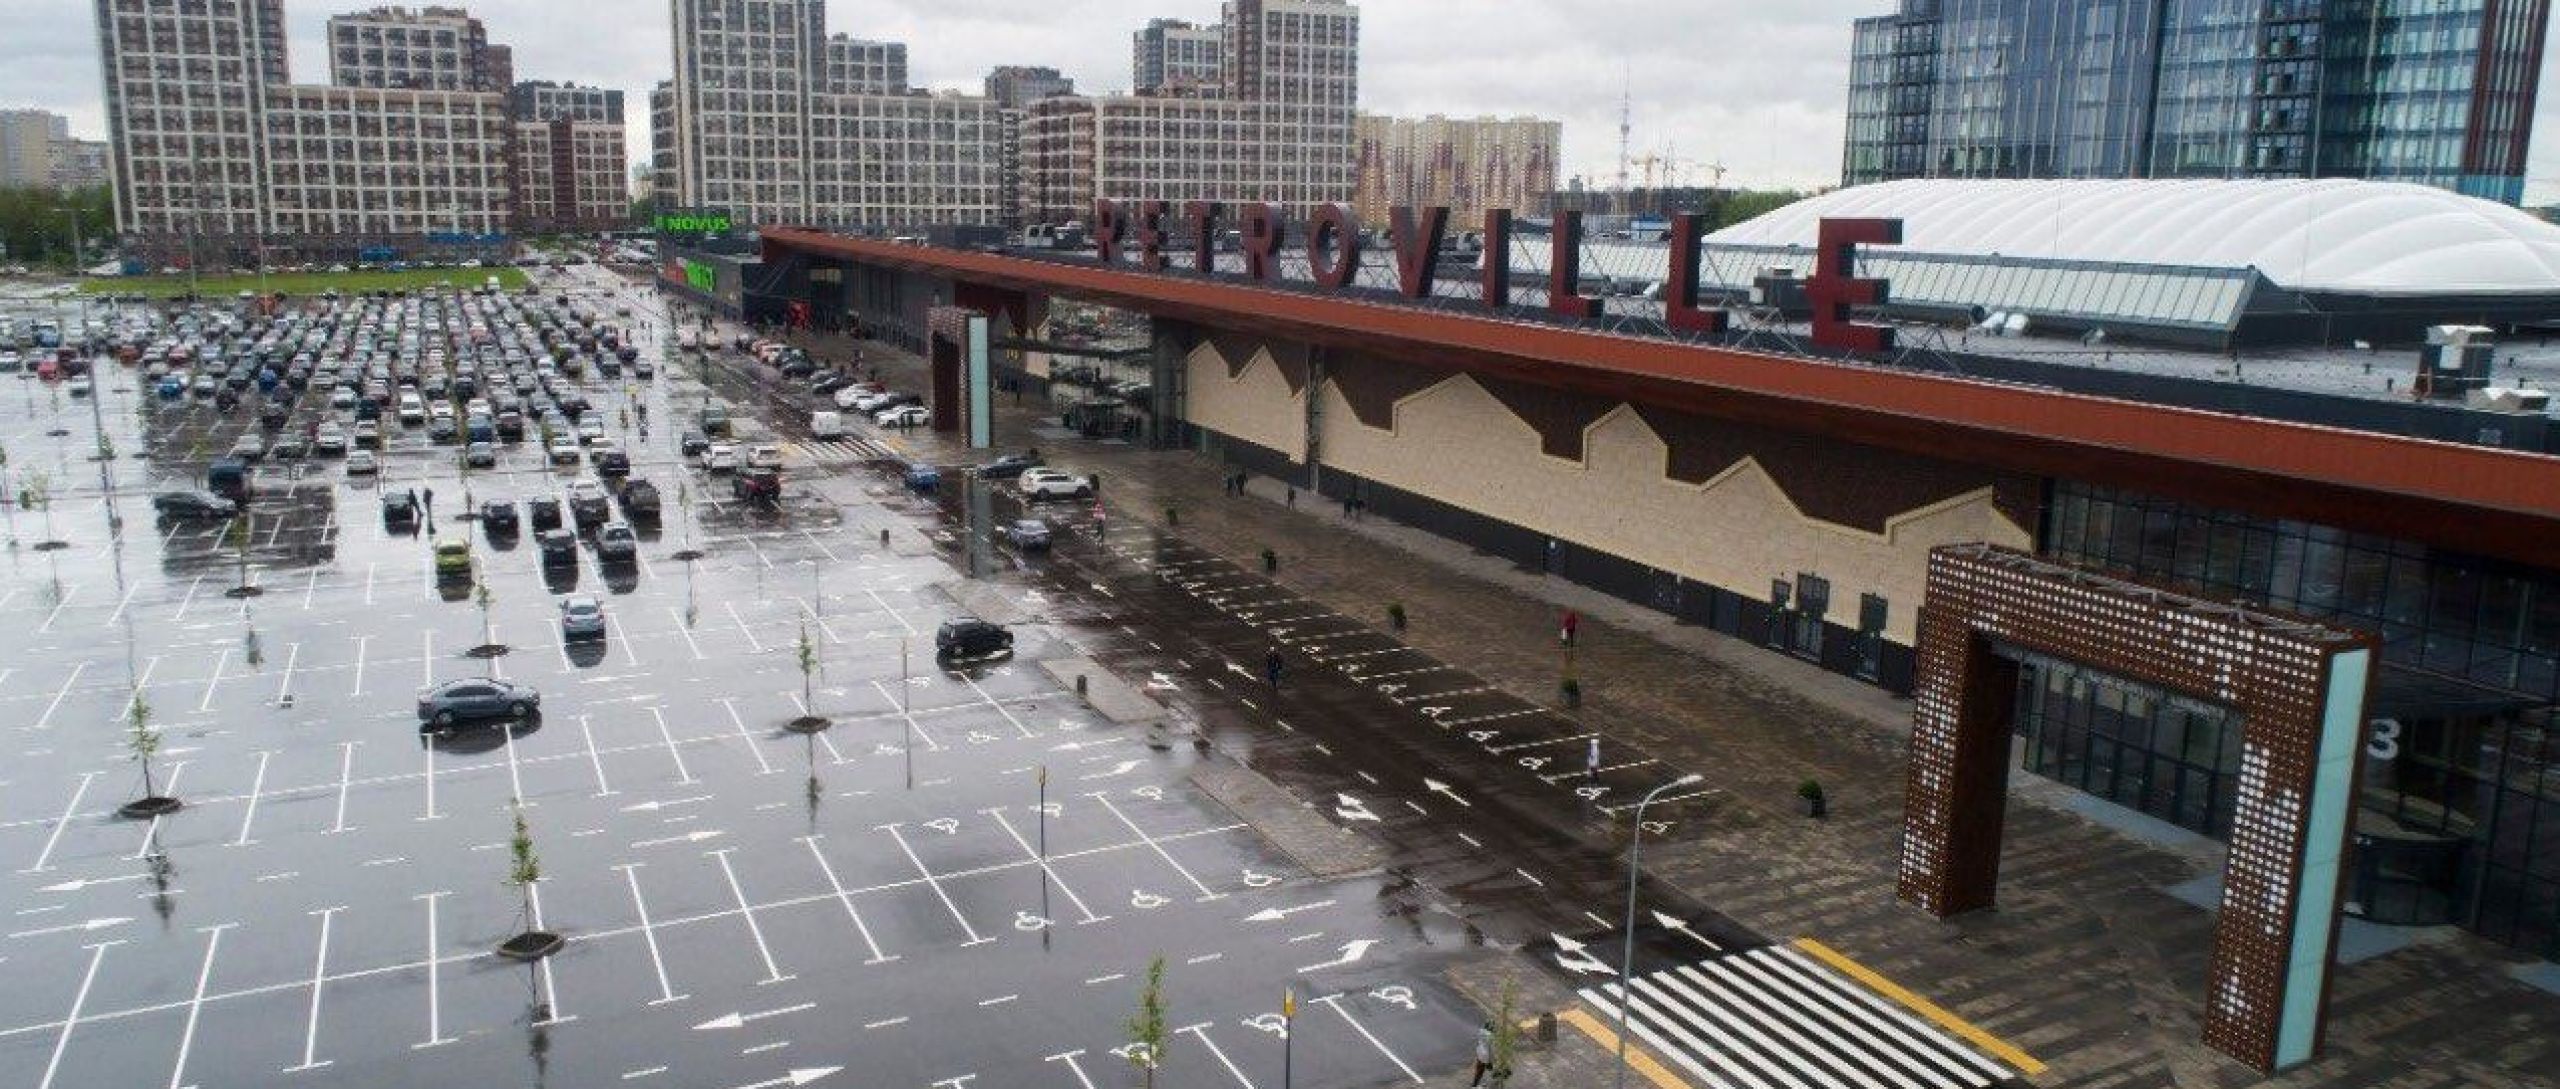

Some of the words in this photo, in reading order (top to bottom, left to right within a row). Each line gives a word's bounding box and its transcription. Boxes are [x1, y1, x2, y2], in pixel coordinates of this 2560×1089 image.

[667, 217, 730, 230] NOVUS
[1095, 200, 1904, 353] RETROVILLE
[2367, 719, 2400, 760] 3
